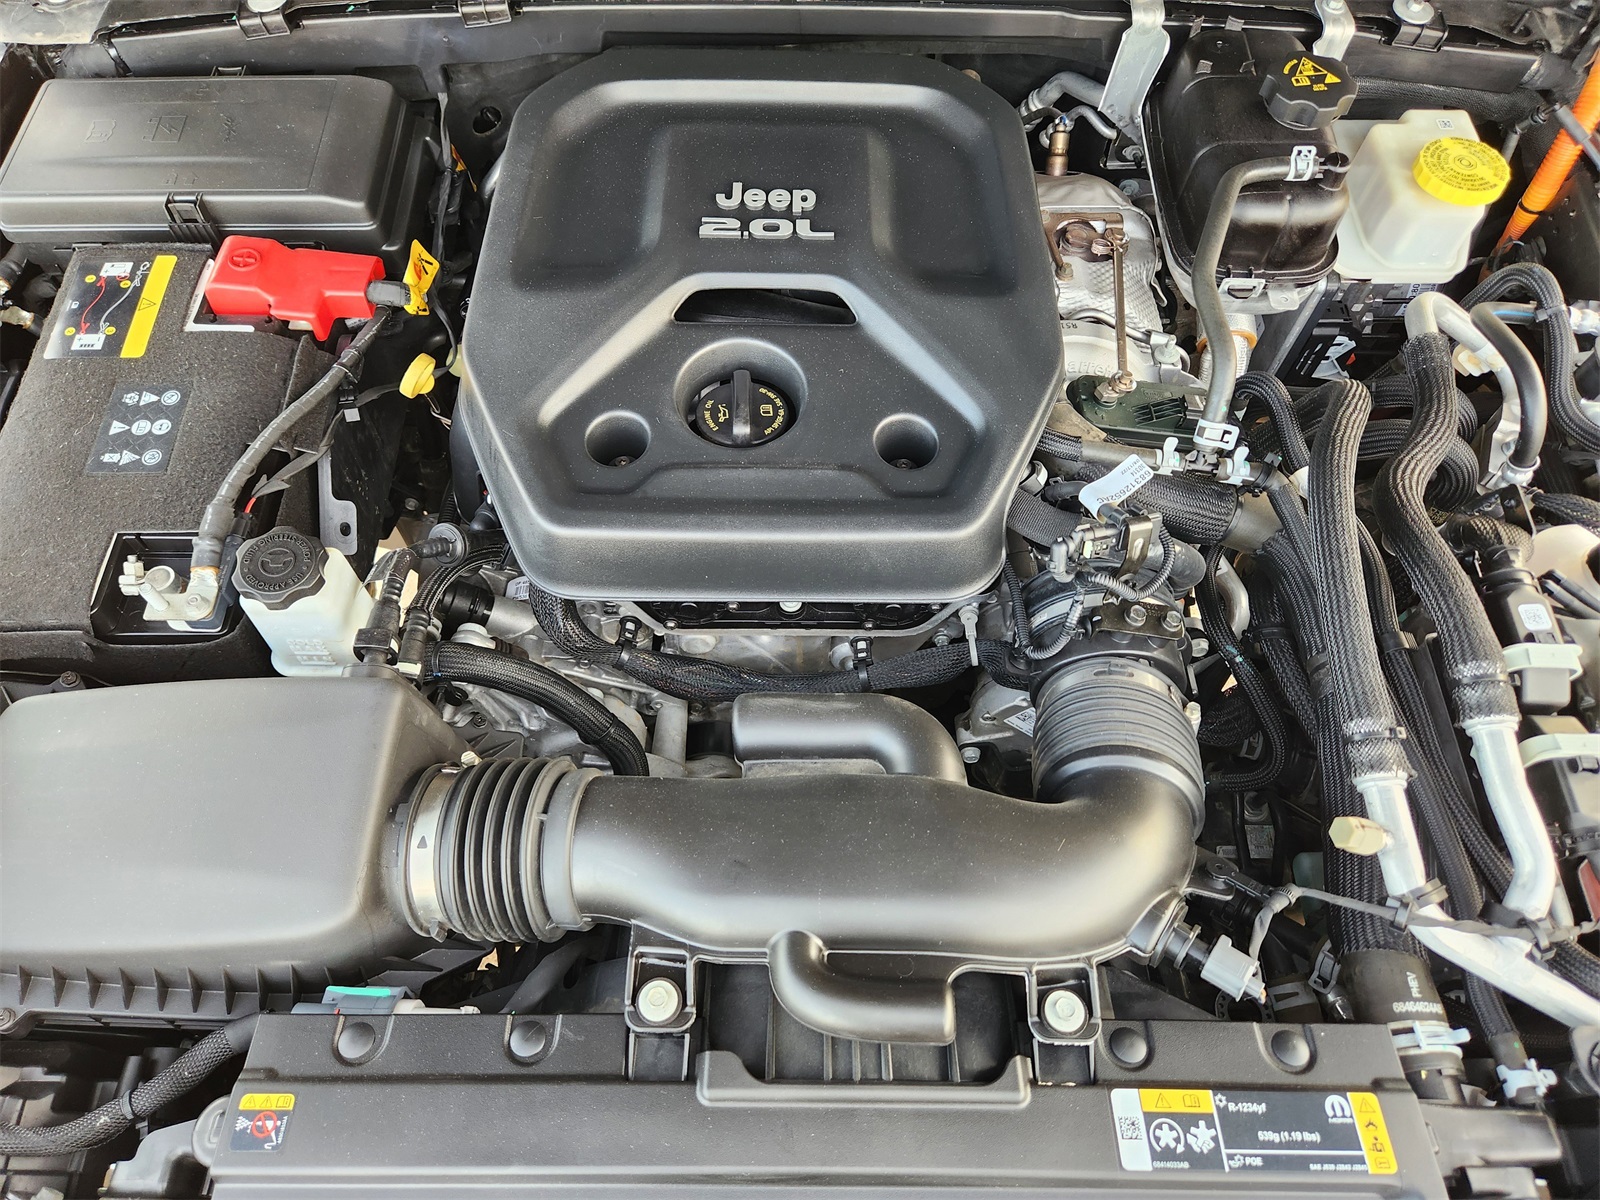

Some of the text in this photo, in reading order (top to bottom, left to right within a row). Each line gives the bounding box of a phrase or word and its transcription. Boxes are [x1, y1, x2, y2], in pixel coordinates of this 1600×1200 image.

[715, 181, 817, 216] Jeep
[698, 216, 835, 240] 2.0L
[703, 410, 719, 432] ENGINE
[1096, 470, 1151, 504] 68312652AC
[243, 533, 311, 564] POWER STEERING FLUID
[245, 571, 304, 591] USE APPROVED
[1406, 971, 1423, 998] PHEV
[1228, 1102, 1266, 1115] R-1234yf
